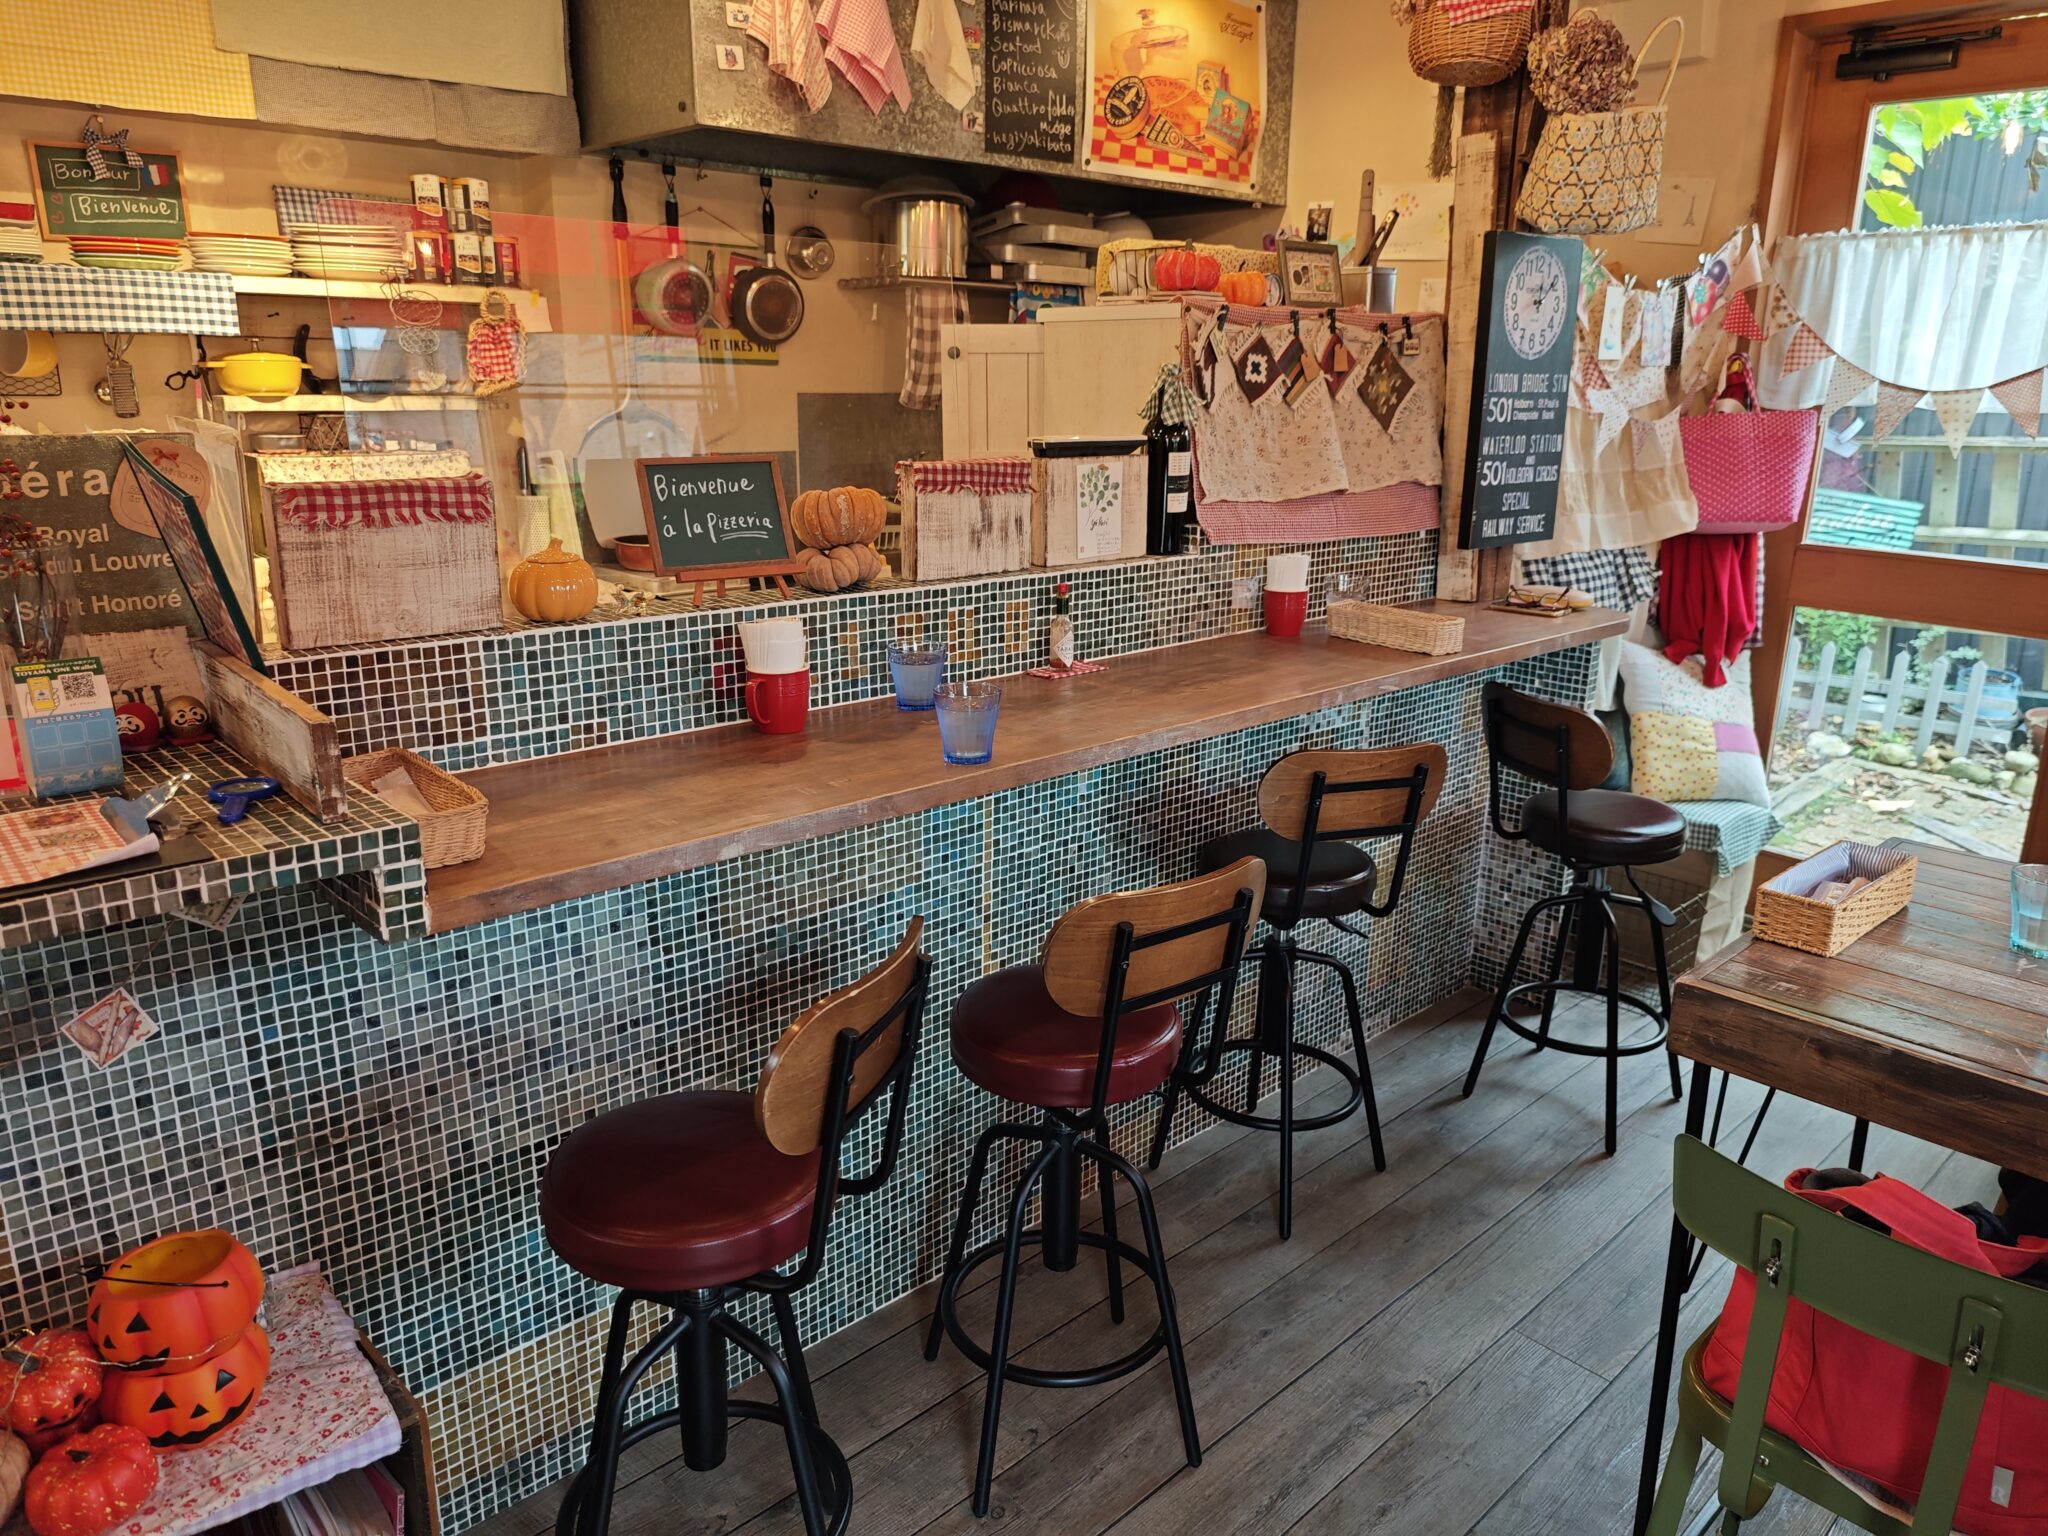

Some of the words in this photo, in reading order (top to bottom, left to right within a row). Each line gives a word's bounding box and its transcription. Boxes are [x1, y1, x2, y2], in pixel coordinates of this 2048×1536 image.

[992, 13, 1056, 40] Bismarck
[993, 76, 1040, 94] Bianca
[54, 162, 131, 183] Bonur
[1525, 258, 1534, 277] 11
[1535, 255, 1545, 273] 12
[1547, 261, 1552, 279] 1
[1516, 273, 1525, 291] 10
[1510, 292, 1518, 311] 9
[1553, 295, 1560, 313] 3
[1512, 313, 1519, 331] 8
[1547, 315, 1554, 332] 4
[709, 338, 720, 351] IT
[724, 338, 753, 352] LIKES
[1519, 327, 1526, 345] 7
[1528, 332, 1535, 351] 6
[1539, 328, 1546, 346] 5
[1488, 373, 1518, 393] LONDON
[1521, 373, 1549, 393] BRIDGE
[1552, 373, 1569, 393] STN
[1486, 396, 1513, 423] 501
[1482, 435, 1526, 456] WATERLOO
[1530, 433, 1563, 454] STATION
[1480, 460, 1507, 486] 501
[654, 474, 755, 501] Bienvenue
[1502, 492, 1530, 512] SPECIAL
[1482, 516, 1514, 538] RAILWAY
[1516, 514, 1546, 535] SERVICE
[92, 588, 183, 614] Honoré
[15, 668, 52, 678] TOYAMA
[72, 663, 98, 671] Wallet
